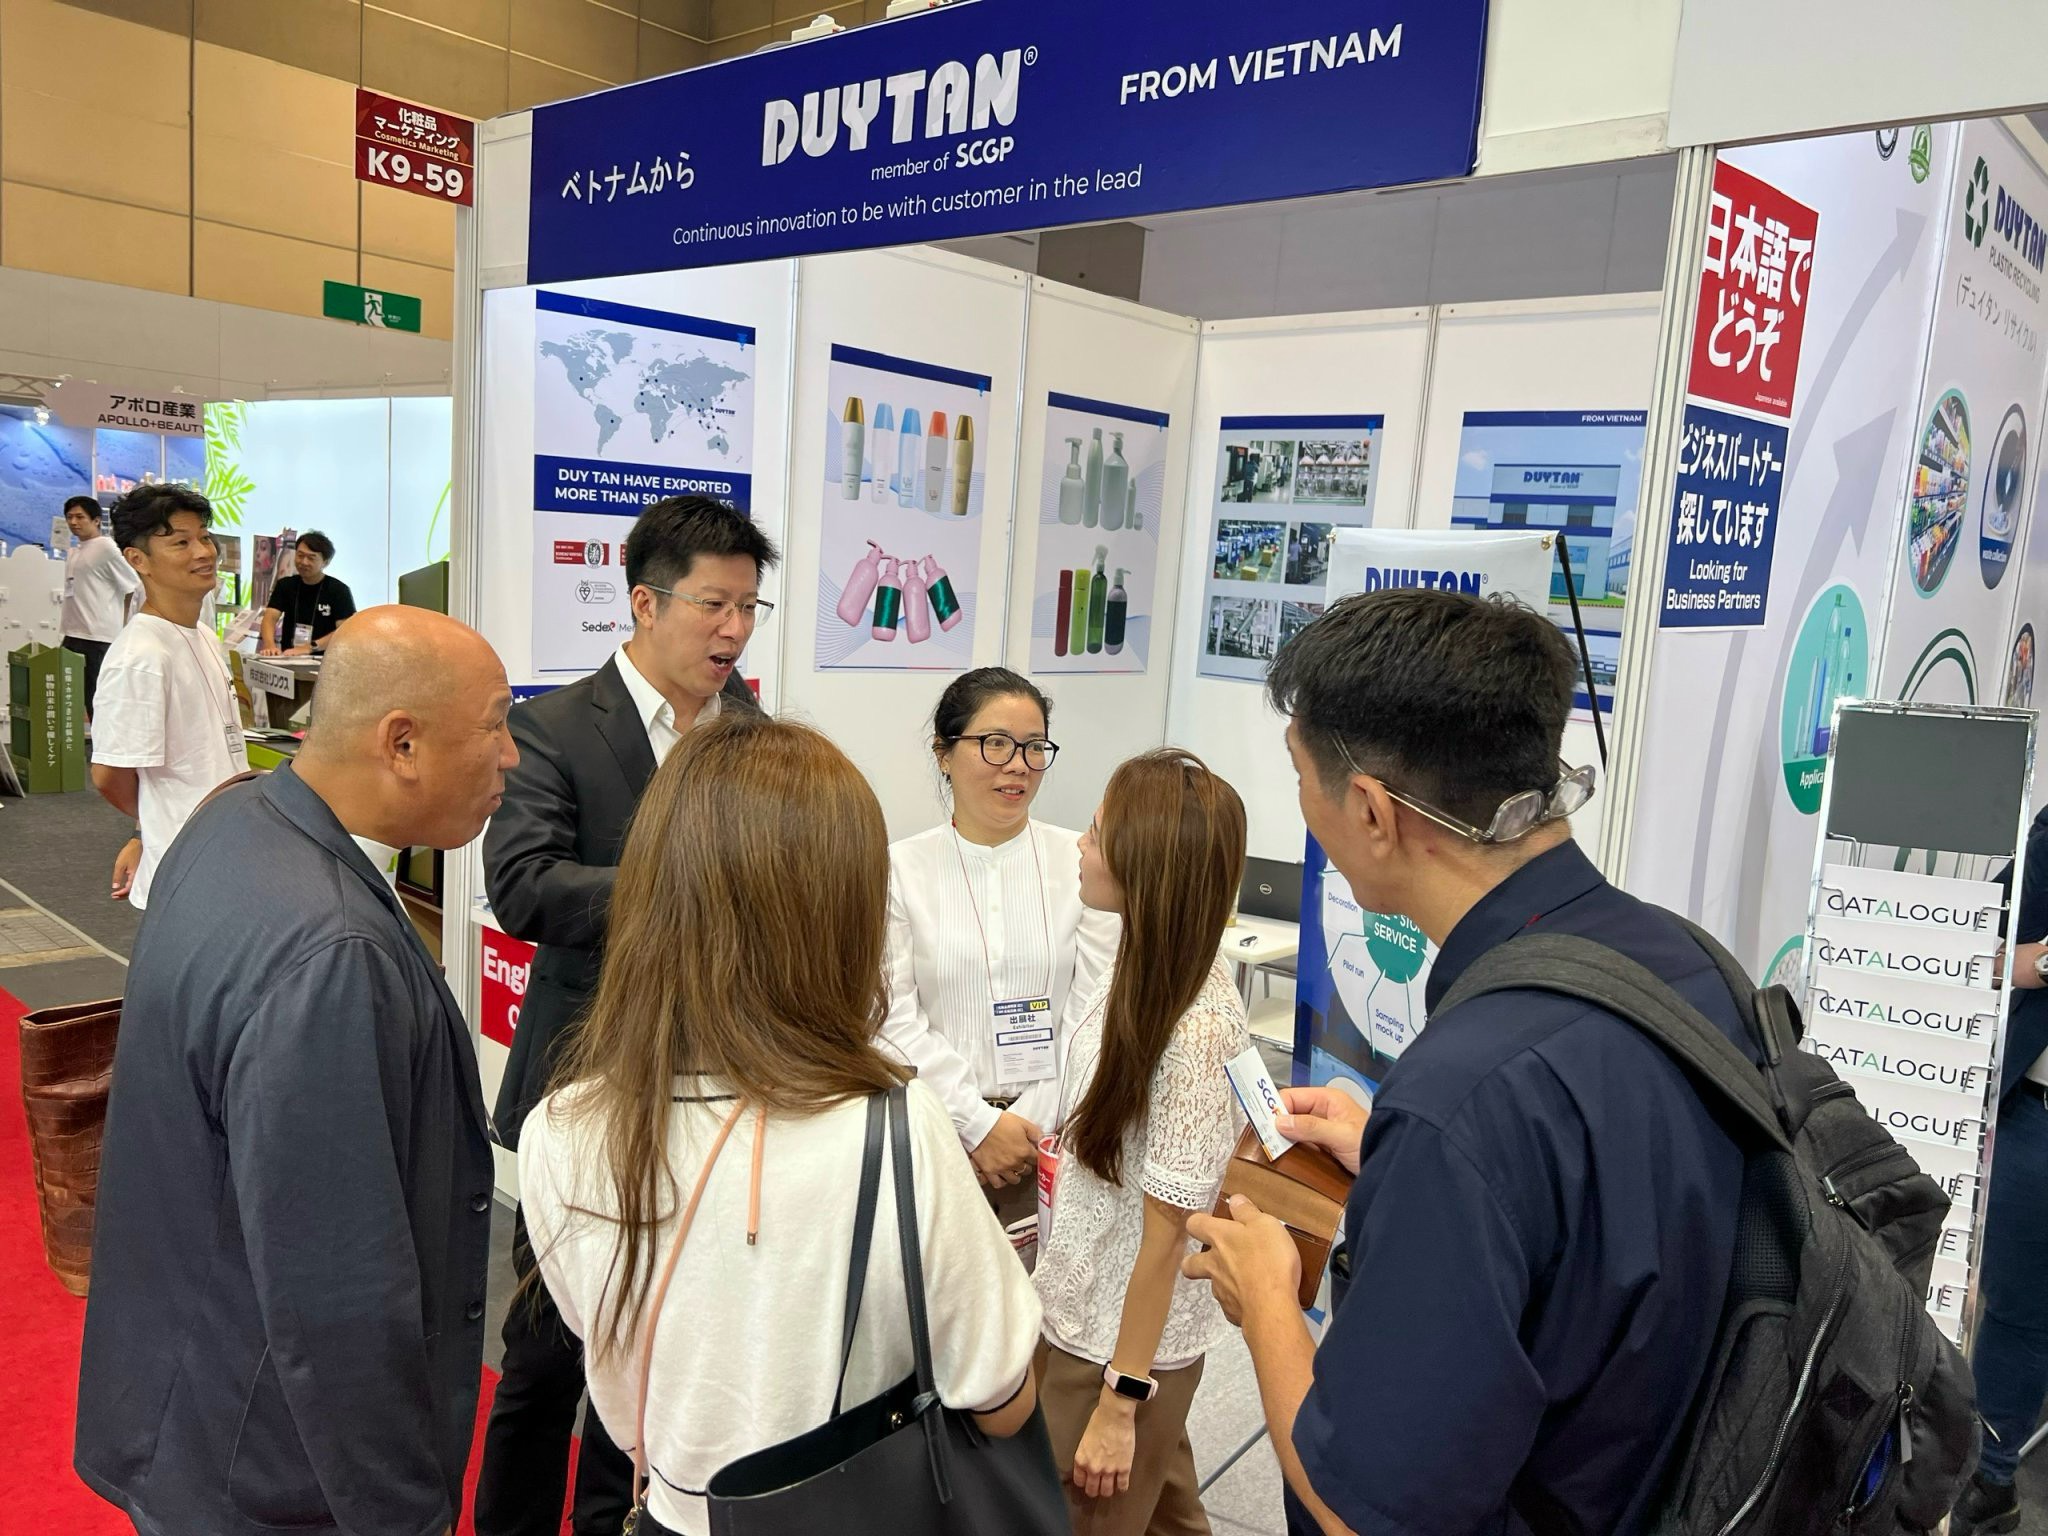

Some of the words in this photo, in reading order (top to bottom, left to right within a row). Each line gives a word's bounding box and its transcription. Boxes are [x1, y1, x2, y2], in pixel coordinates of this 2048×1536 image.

[1119, 58, 1217, 106] FROM
[1228, 23, 1404, 86] VIETNAM
[374, 115, 461, 149] マーケティング
[398, 107, 437, 131] 化粧品
[374, 130, 417, 149] Cosmetics
[418, 143, 459, 162] Marketing
[871, 157, 930, 181] member
[933, 151, 950, 173] of
[955, 135, 1015, 168] SCGP
[368, 146, 464, 198] K9-59
[560, 151, 695, 205] ベトナムから
[672, 221, 753, 245] Continuous
[755, 207, 836, 236] innovation
[841, 206, 858, 224] to
[862, 201, 884, 221] be
[887, 194, 927, 218] with
[931, 183, 1024, 213] customer
[1029, 177, 1048, 201] in
[1053, 172, 1090, 199] the
[1094, 163, 1143, 192] lead
[1993, 184, 2048, 275] DUYTAN
[1702, 190, 1813, 308] 日本語で
[1989, 245, 2013, 280] PLASTIC
[1708, 288, 1785, 382] どうぞ
[109, 394, 196, 419] アポロ産業
[1581, 414, 1605, 423] FROM
[1606, 414, 1642, 423] VIETNAM
[97, 413, 205, 434] APOLLO+BEAUTY
[1677, 423, 1783, 487] ビジネスパートナー
[555, 486, 597, 502] MORE
[600, 489, 639, 505] THAN
[642, 494, 658, 506] 50
[558, 468, 590, 483] DUY
[592, 471, 620, 485] TAN
[623, 473, 661, 489] HAVE
[663, 477, 732, 494] EXPORTED
[1676, 490, 1769, 549] 探しています
[1689, 558, 1731, 584] Looking
[1733, 561, 1748, 581] for
[1666, 588, 1715, 610] Business
[1717, 589, 1761, 610] Partners
[582, 621, 615, 633] Sedex
[1799, 768, 1824, 790] Applica
[1327, 891, 1358, 913] Decoration
[1826, 894, 1989, 929] CATALOGUE
[1373, 921, 1417, 954] SERVICE
[483, 944, 531, 996] Engl
[1342, 958, 1355, 975] Pilot
[1354, 966, 1365, 979] run
[1818, 945, 1981, 981] CATALOGUE
[1031, 1001, 1047, 1009] VIP
[1375, 1008, 1405, 1033] Sampling
[1819, 996, 1982, 1036] CATALOGUE
[1375, 1022, 1394, 1039] mock
[1394, 1029, 1404, 1045] up
[1874, 1107, 1969, 1141] LOGUE
